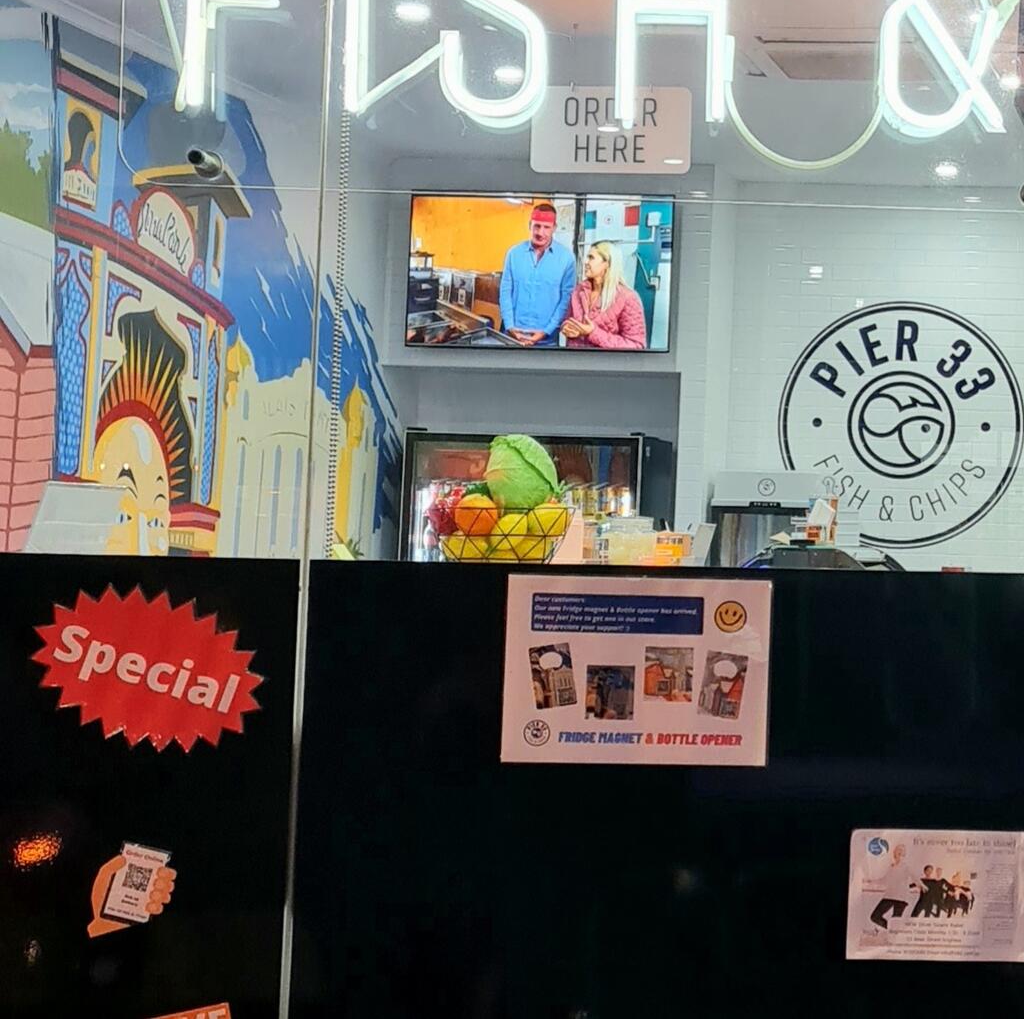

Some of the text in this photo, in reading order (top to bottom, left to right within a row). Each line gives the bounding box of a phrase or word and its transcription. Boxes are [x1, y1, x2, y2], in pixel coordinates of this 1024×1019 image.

[574, 134, 646, 164] HERE
[809, 319, 996, 400] PIER 33
[812, 454, 986, 523] FISH & CHIPS
[52, 622, 241, 714] Special
[558, 731, 743, 747] FRIDGE MAGNET & BOTTLE OPENER
